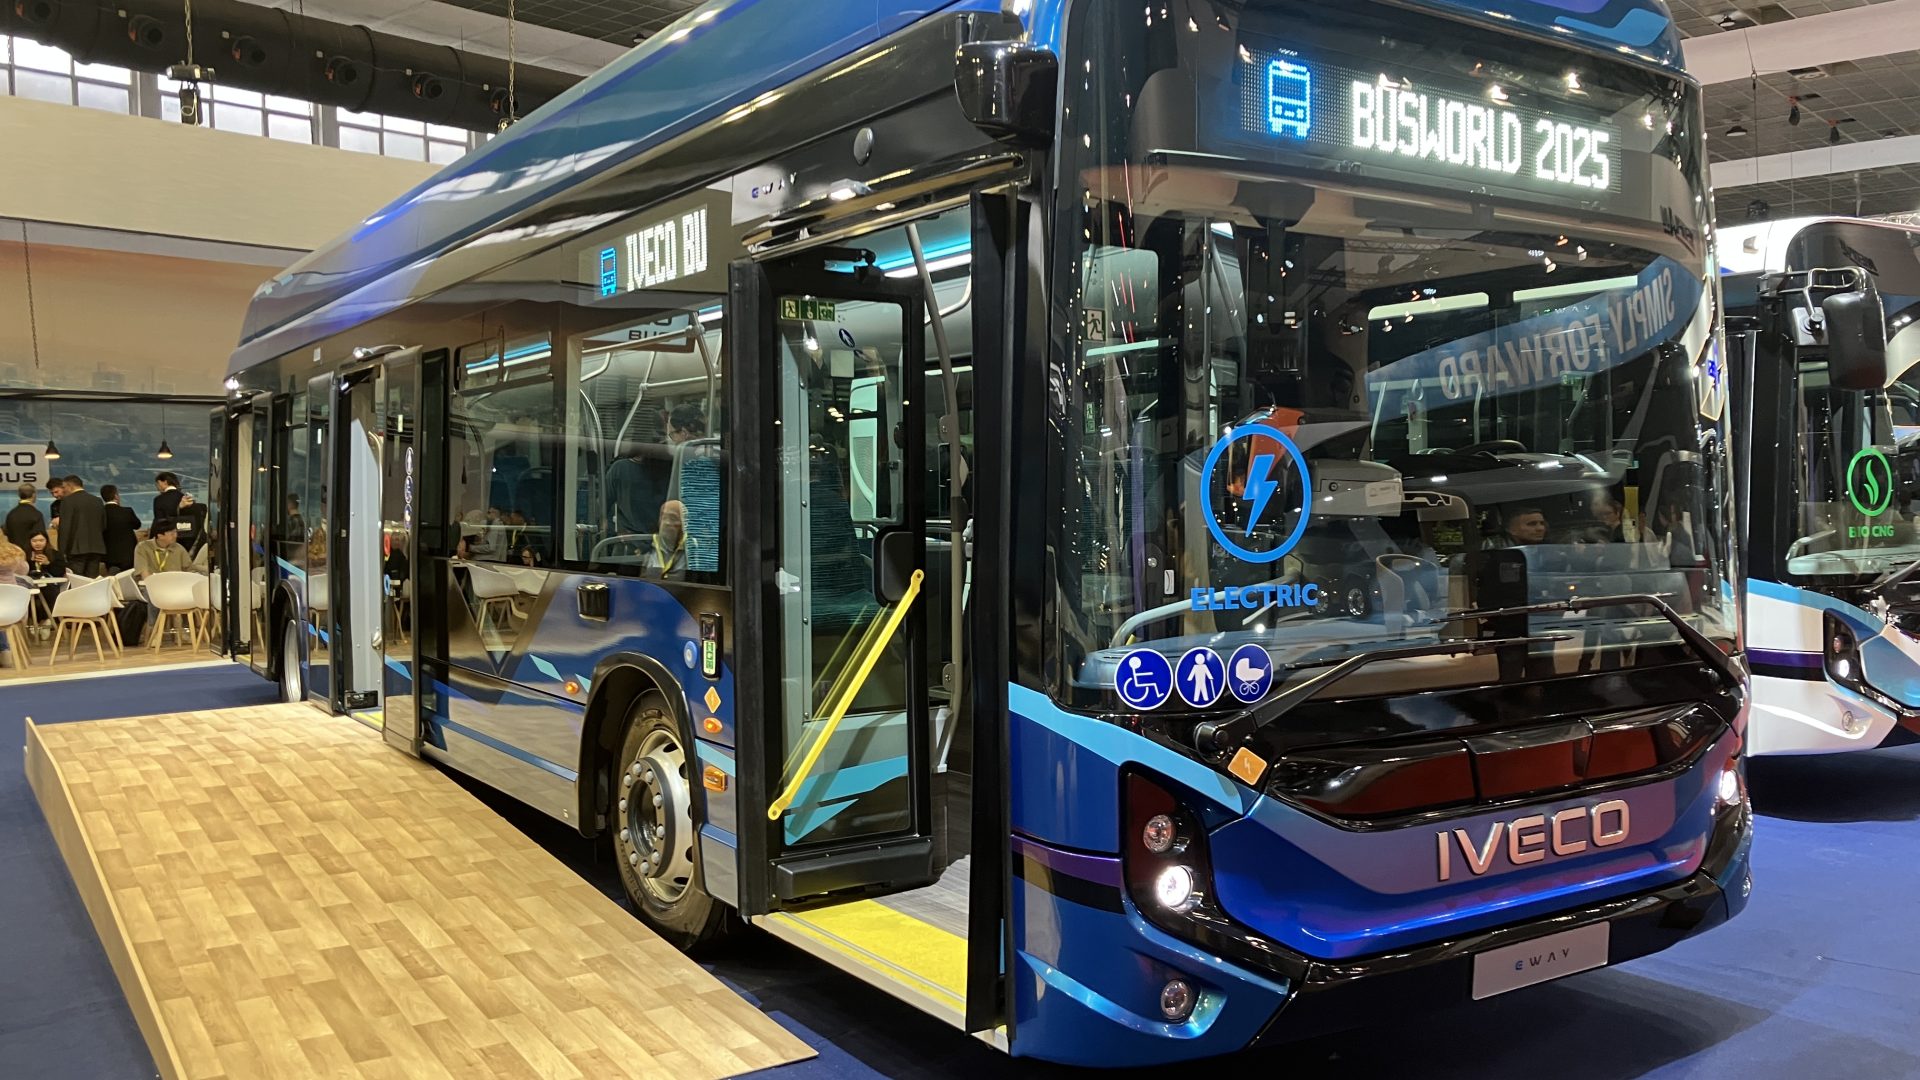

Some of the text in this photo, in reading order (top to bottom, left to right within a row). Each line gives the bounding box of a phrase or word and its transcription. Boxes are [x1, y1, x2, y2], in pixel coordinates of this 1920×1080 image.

[1352, 80, 1610, 190] BUSWORLD 2025
[626, 208, 708, 292] IVECO BU
[0, 472, 37, 483] US
[1848, 525, 1894, 538] BIO CNG
[1190, 583, 1319, 611] ELECTRIC
[1436, 799, 1630, 881] IVECO
[1515, 948, 1569, 970] EWAY
